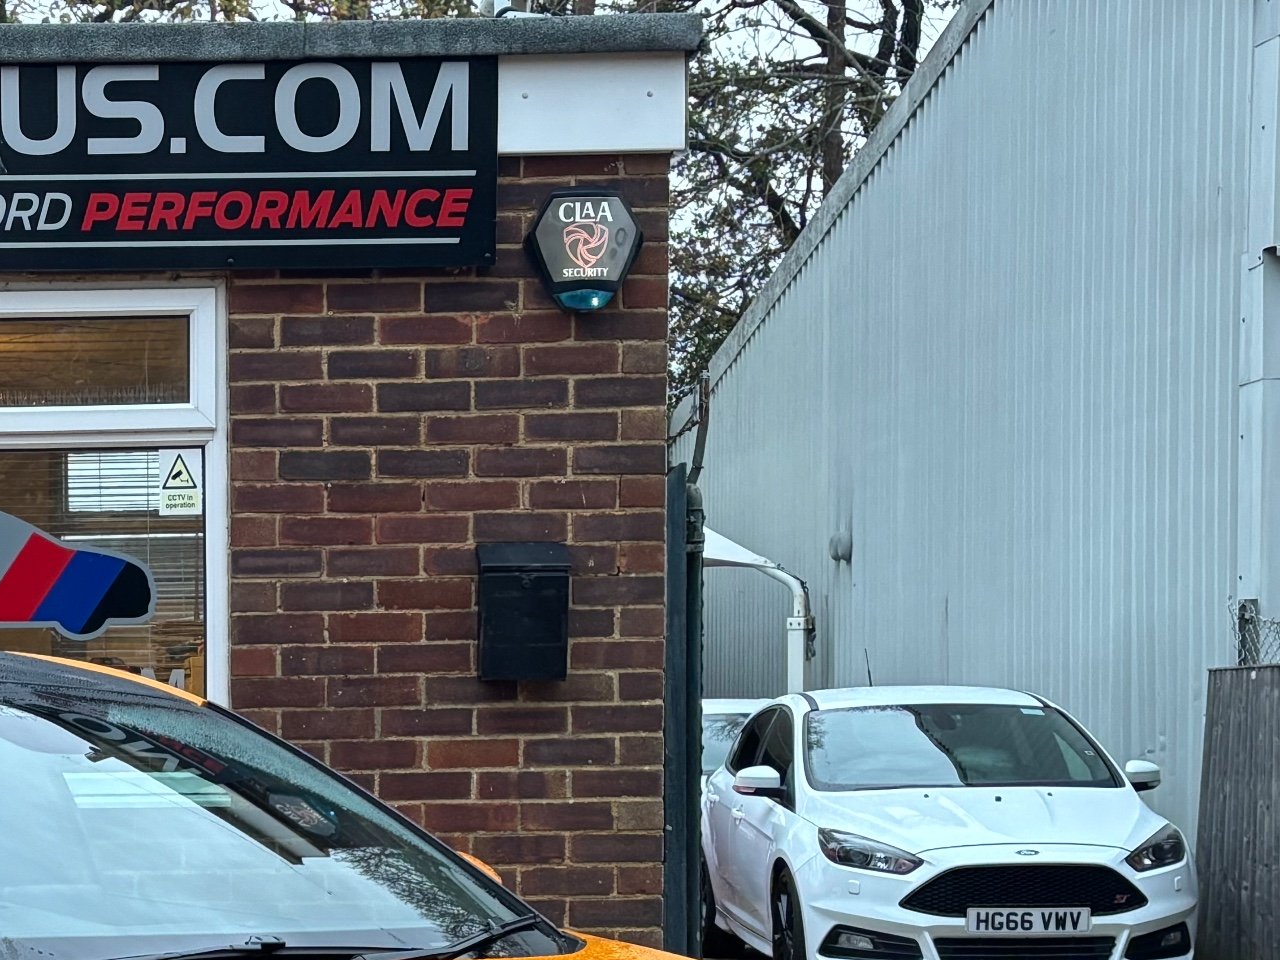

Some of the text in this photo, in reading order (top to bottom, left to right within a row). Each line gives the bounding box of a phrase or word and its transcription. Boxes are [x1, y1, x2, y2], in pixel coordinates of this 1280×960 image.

[80, 188, 473, 232] PERFORMANCE
[562, 267, 609, 278] SECURITY
[186, 493, 193, 501] in
[165, 502, 195, 510] operation
[975, 911, 1082, 931] HG66 VWV
